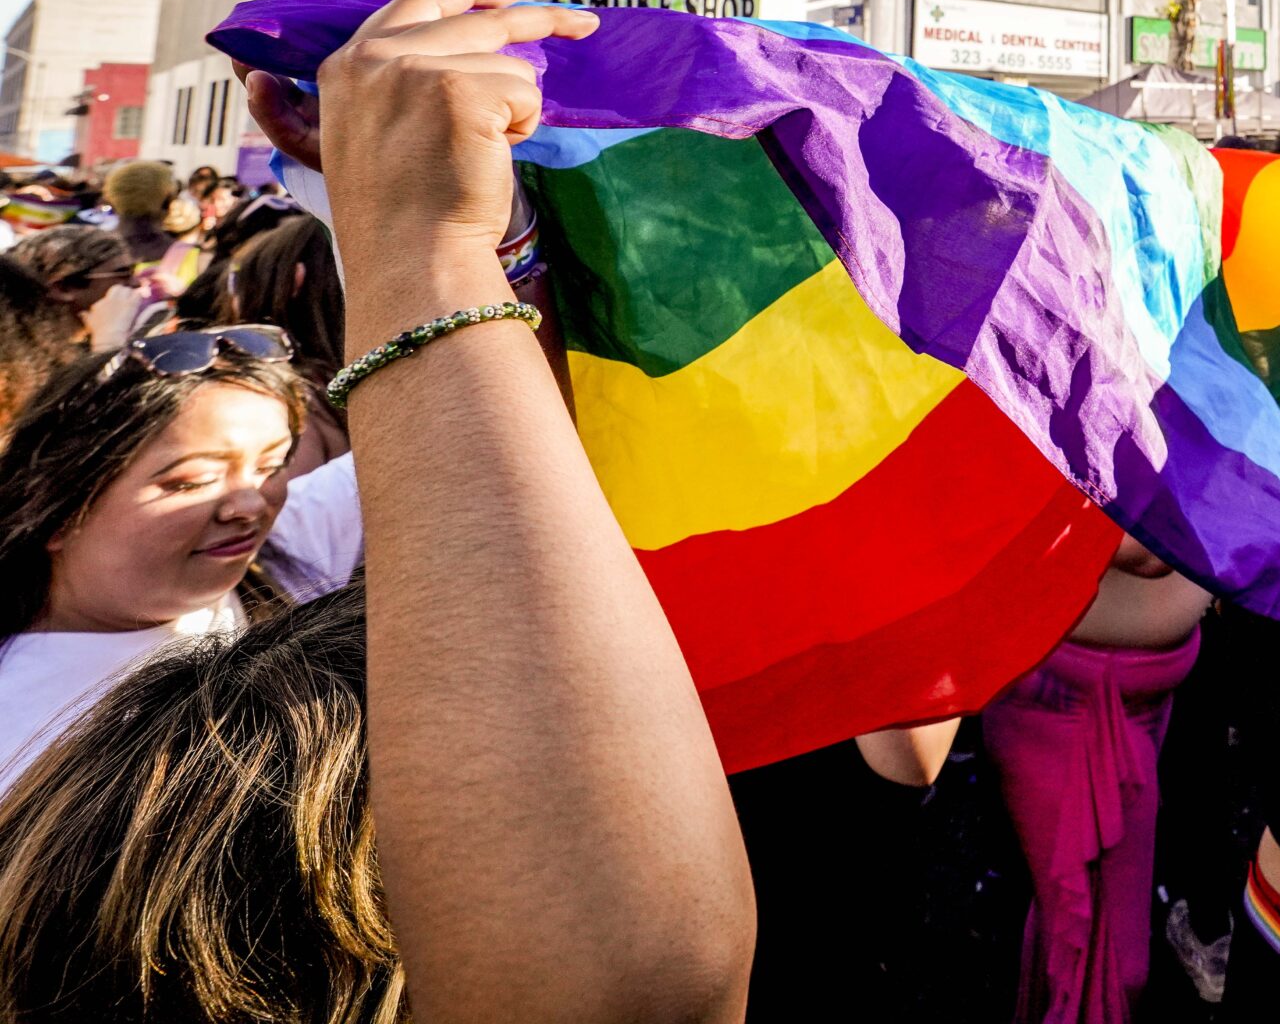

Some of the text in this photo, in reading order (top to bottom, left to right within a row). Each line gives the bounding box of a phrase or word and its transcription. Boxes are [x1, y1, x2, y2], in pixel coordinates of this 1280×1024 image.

[924, 27, 983, 44] MEDICAL
[1001, 34, 1047, 49] DENTAL
[1055, 39, 1101, 53] CENTERS
[951, 49, 981, 65] 323
[997, 53, 1026, 68] 469
[1038, 55, 1073, 71] 5555
